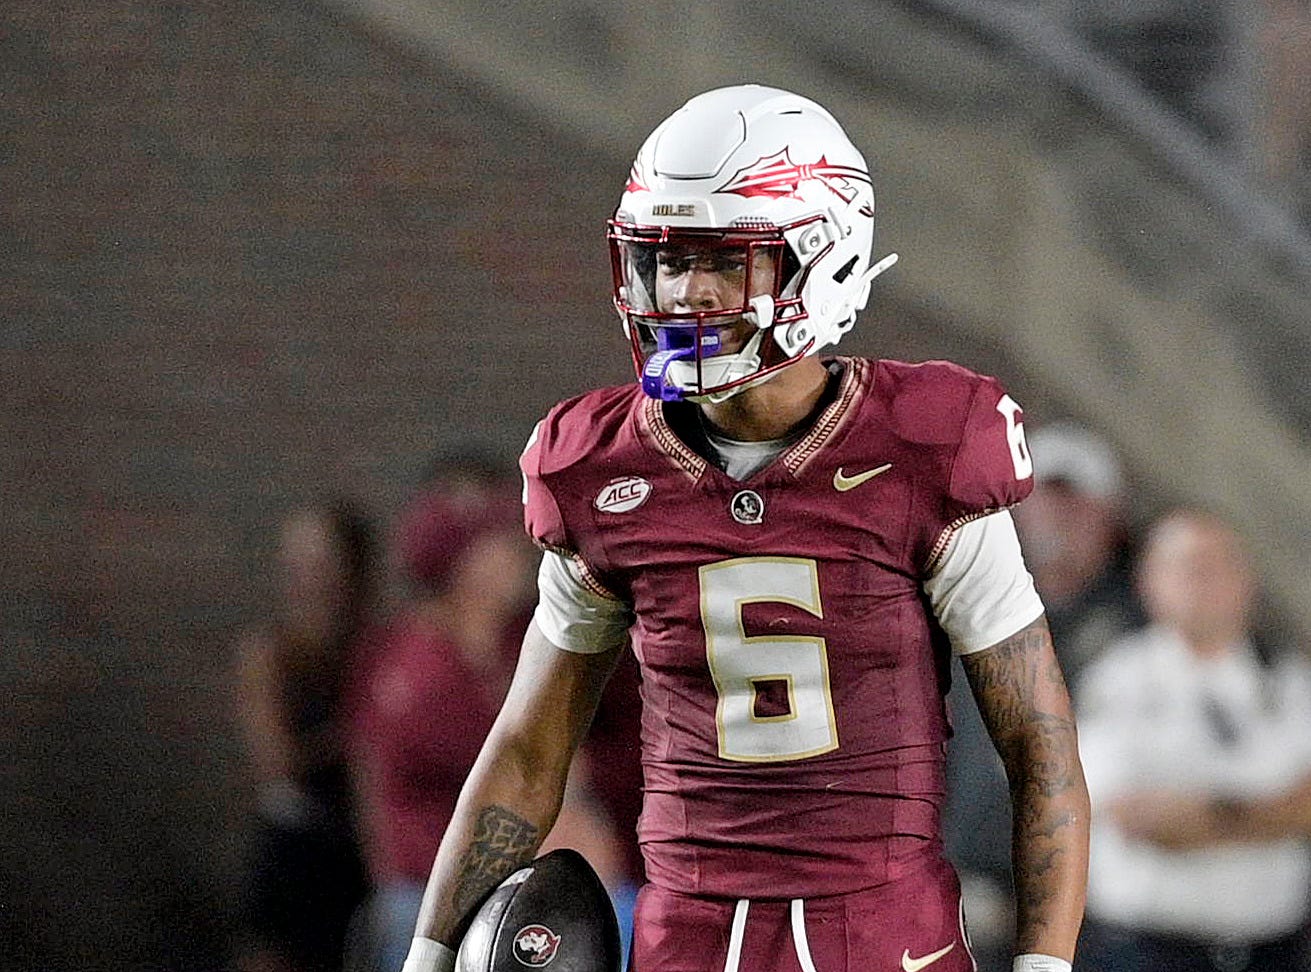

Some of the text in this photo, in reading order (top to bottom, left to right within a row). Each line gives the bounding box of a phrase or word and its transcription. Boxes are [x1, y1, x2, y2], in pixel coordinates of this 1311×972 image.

[995, 393, 1034, 481] 6
[603, 483, 642, 505] ACC
[697, 556, 840, 763] 6
